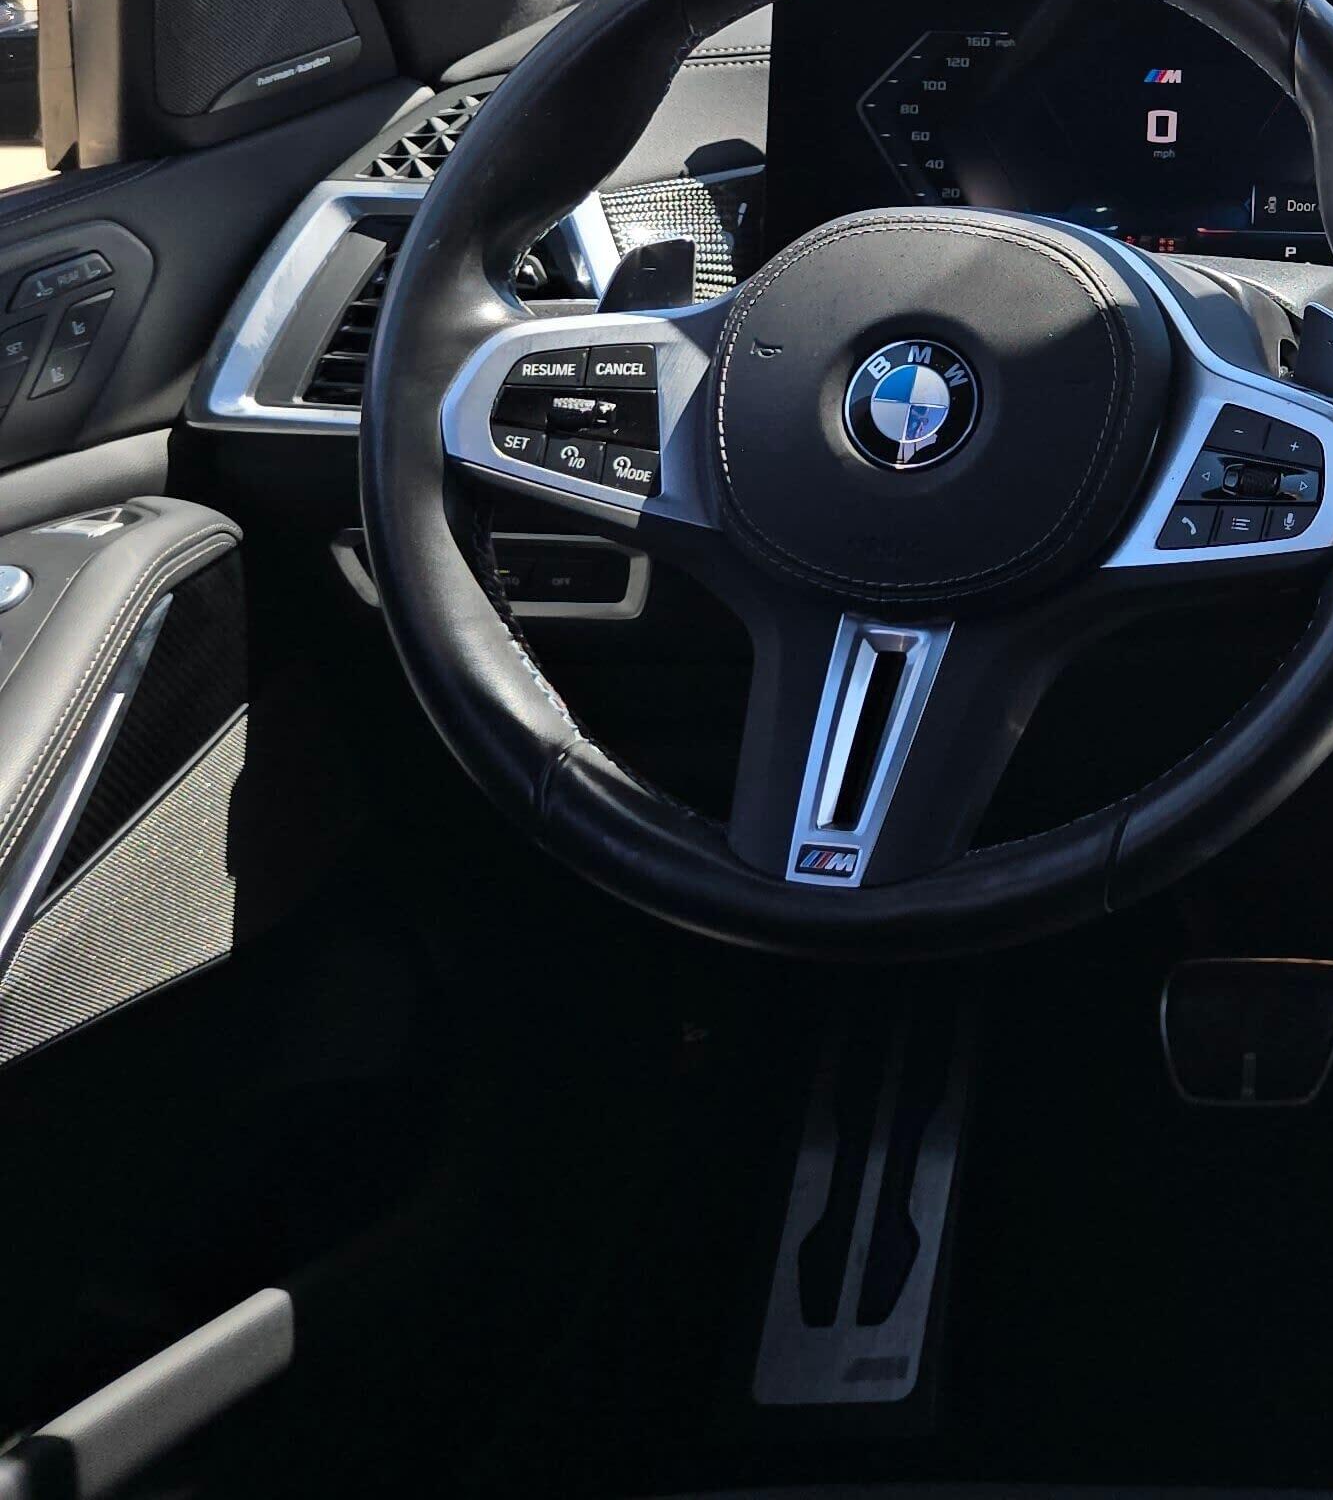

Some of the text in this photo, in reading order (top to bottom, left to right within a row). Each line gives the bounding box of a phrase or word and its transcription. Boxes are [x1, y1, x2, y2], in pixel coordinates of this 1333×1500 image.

[966, 36, 1016, 47] 160 mph
[946, 57, 970, 68] 120
[921, 80, 947, 91] 100
[900, 104, 919, 115] 80
[1147, 109, 1178, 143] 0
[911, 131, 930, 142] 60
[1153, 149, 1176, 159] mph
[925, 159, 945, 170] 40
[941, 188, 960, 199] 20
[1287, 199, 1316, 212] Door
[1285, 246, 1297, 258] P
[522, 362, 577, 376] RESUME
[595, 362, 647, 376] CANCEL
[866, 345, 969, 388] BMW
[503, 435, 531, 449] SET
[616, 467, 653, 482] MODE
